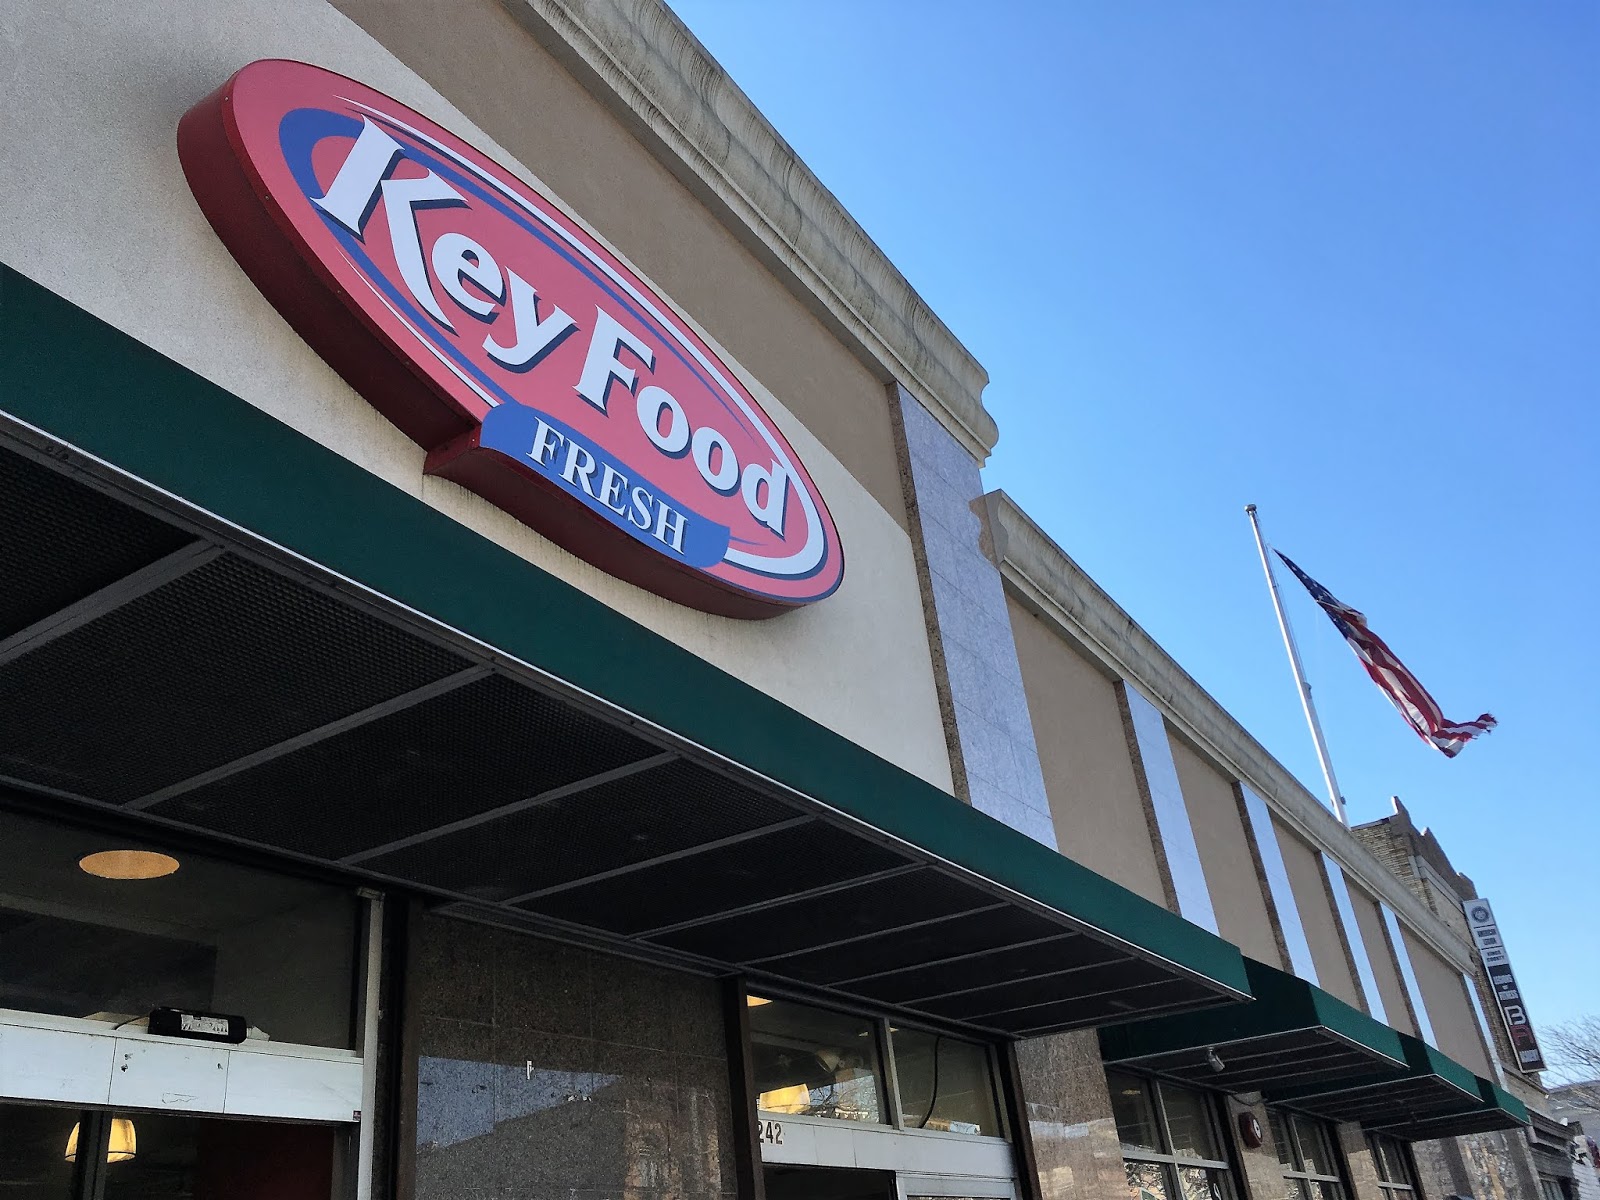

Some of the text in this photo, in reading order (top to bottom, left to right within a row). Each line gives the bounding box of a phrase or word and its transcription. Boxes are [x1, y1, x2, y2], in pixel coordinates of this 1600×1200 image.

[309, 114, 789, 538] Key Food
[525, 416, 690, 556] FRESH
